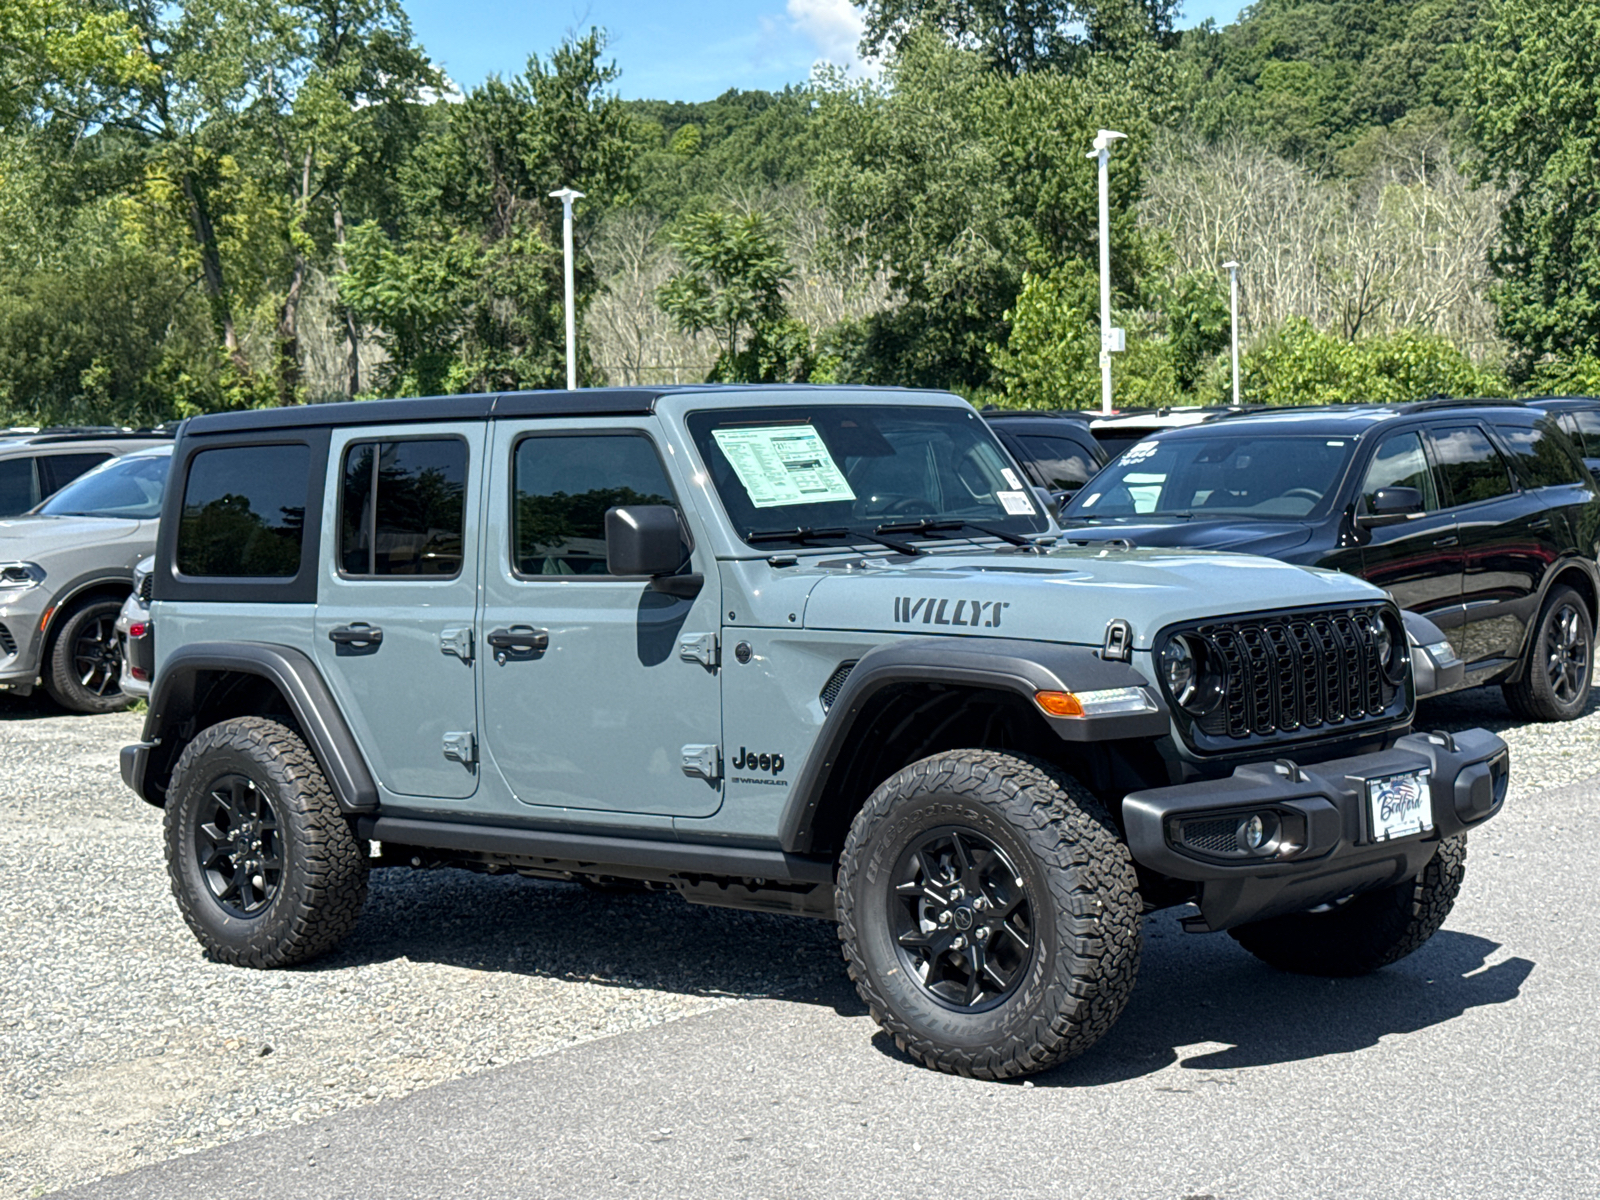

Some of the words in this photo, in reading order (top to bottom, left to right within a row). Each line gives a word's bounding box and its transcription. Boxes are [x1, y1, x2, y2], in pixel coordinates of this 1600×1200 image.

[895, 597, 1010, 628] WILLYS
[732, 746, 785, 776] Jeep
[740, 777, 788, 787] WRANGLER
[866, 803, 995, 884] BFGoodrich
